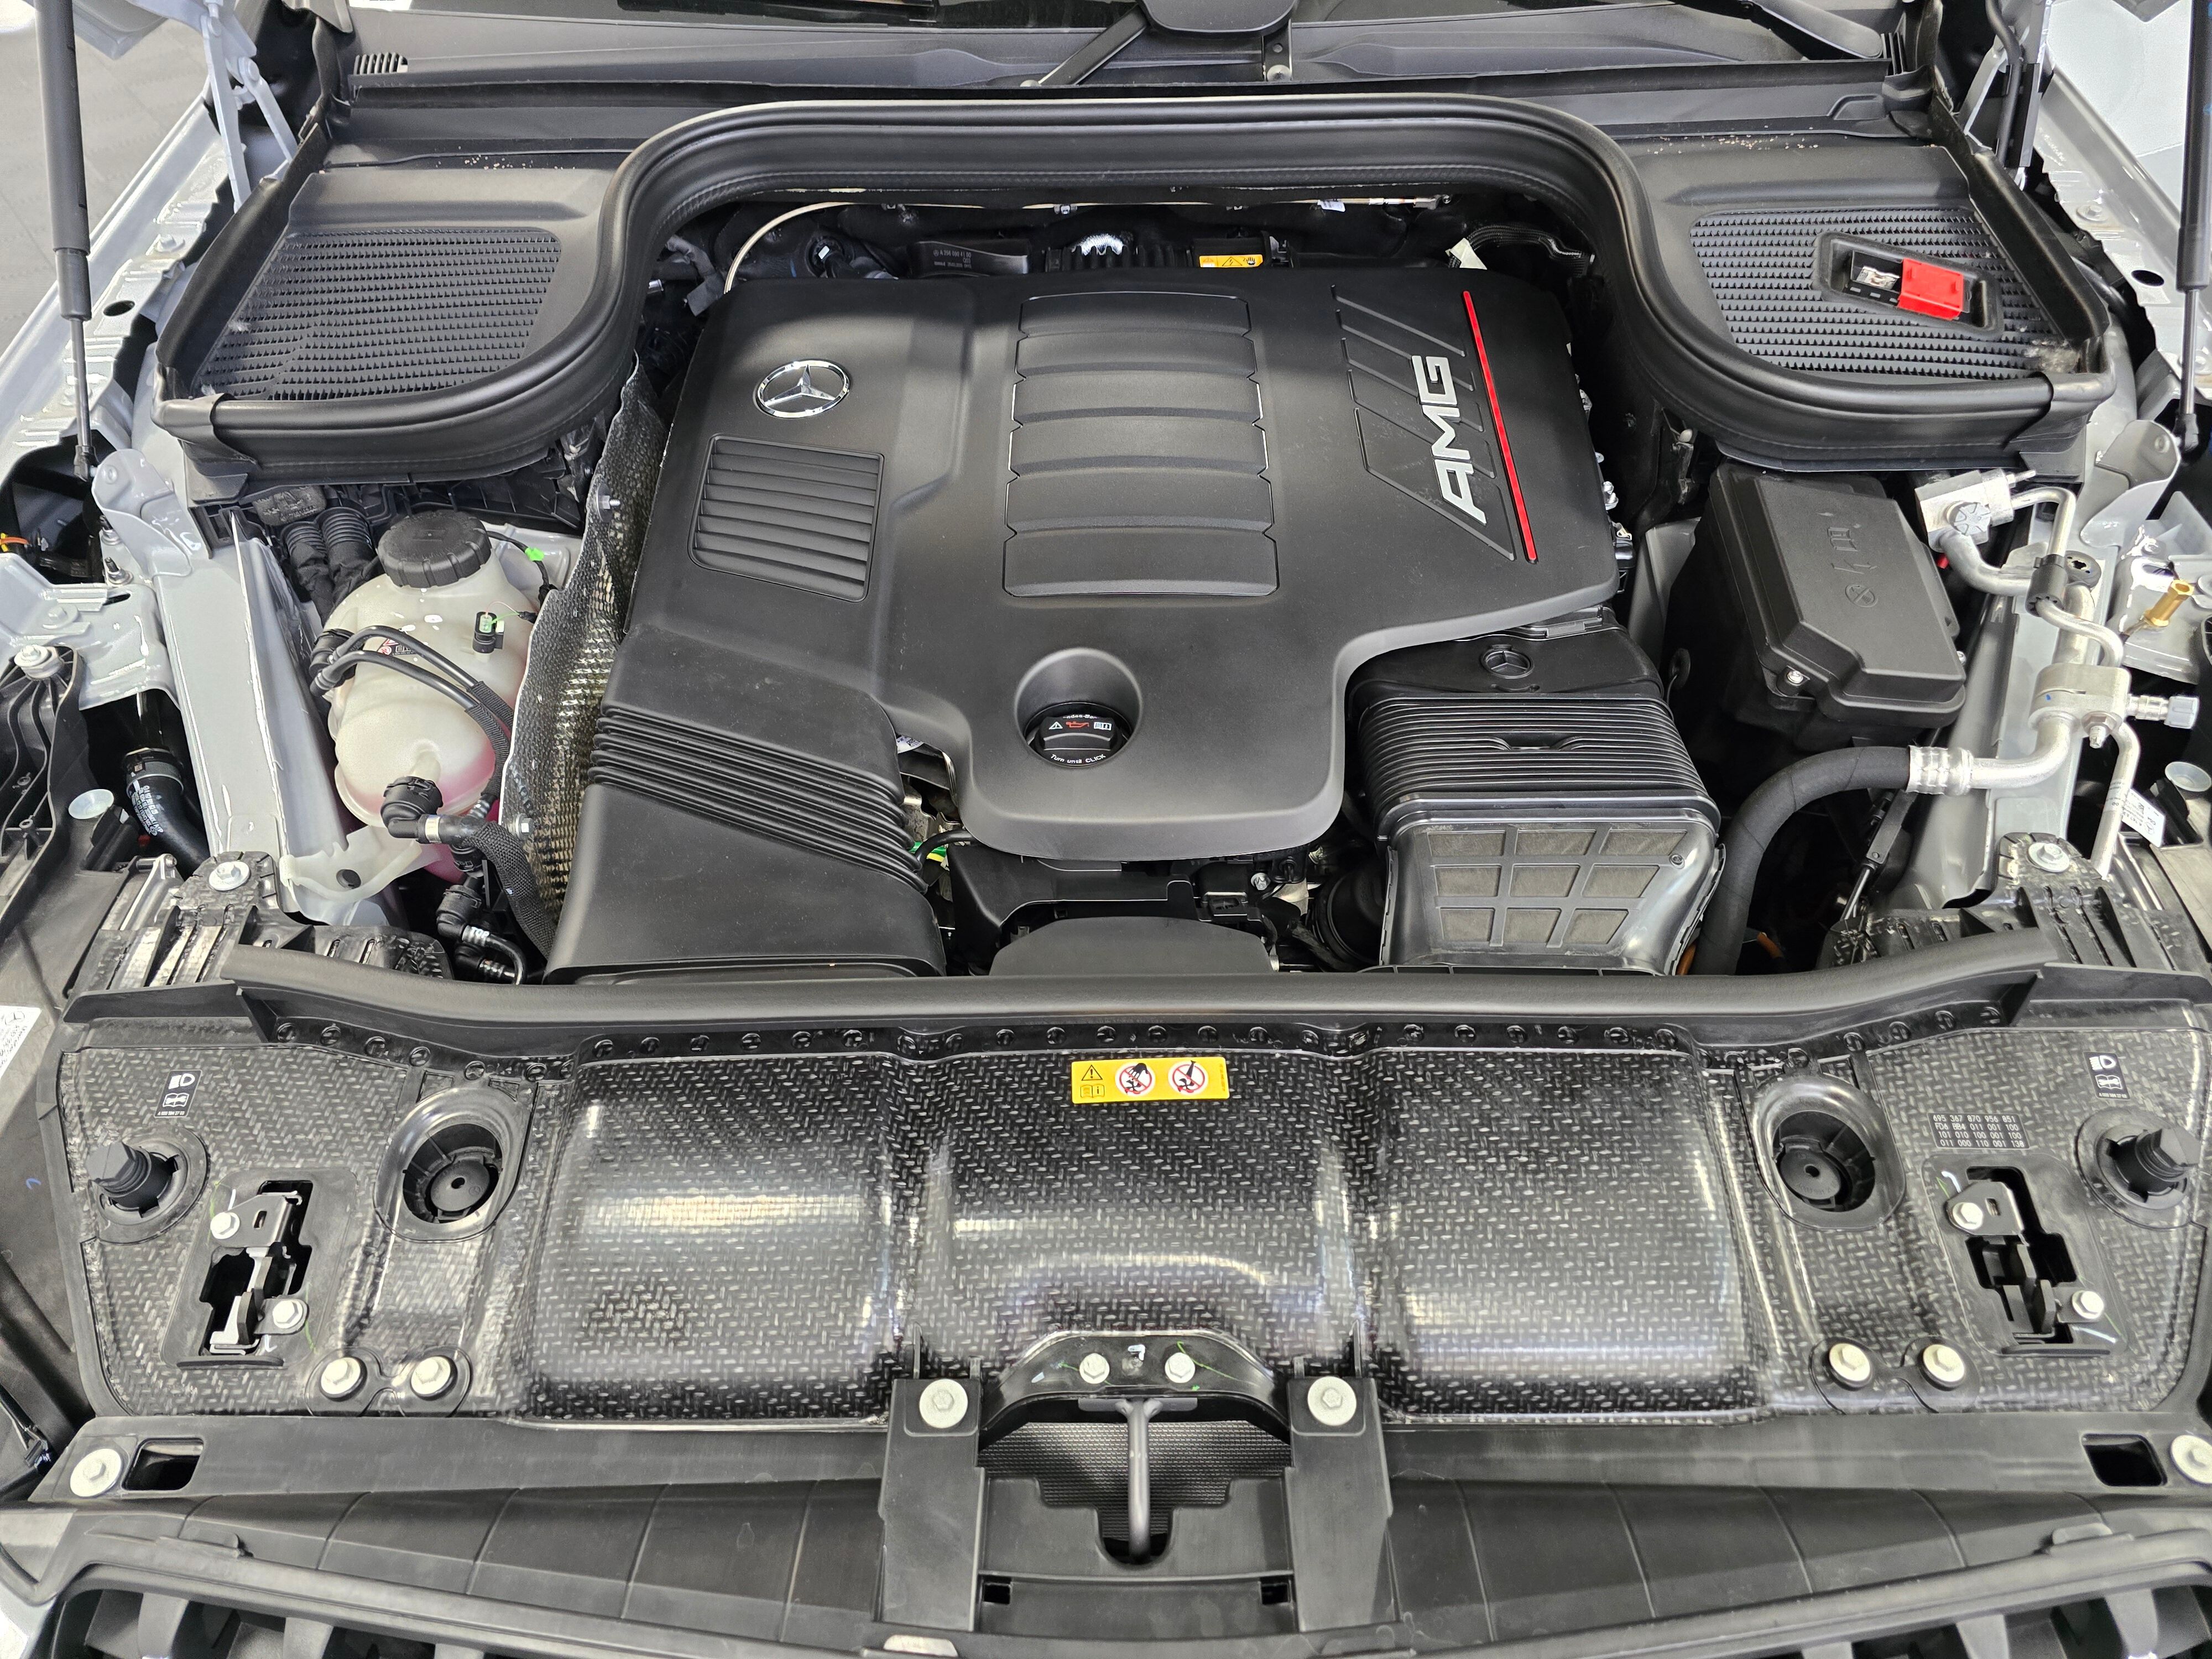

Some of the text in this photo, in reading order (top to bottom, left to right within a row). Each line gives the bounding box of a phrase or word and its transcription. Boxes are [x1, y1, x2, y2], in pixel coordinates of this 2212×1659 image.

[1411, 356, 1486, 525] AMG
[1051, 754, 1065, 762] Turn
[1085, 754, 1106, 763] CLICK
[470, 926, 490, 938] TOP
